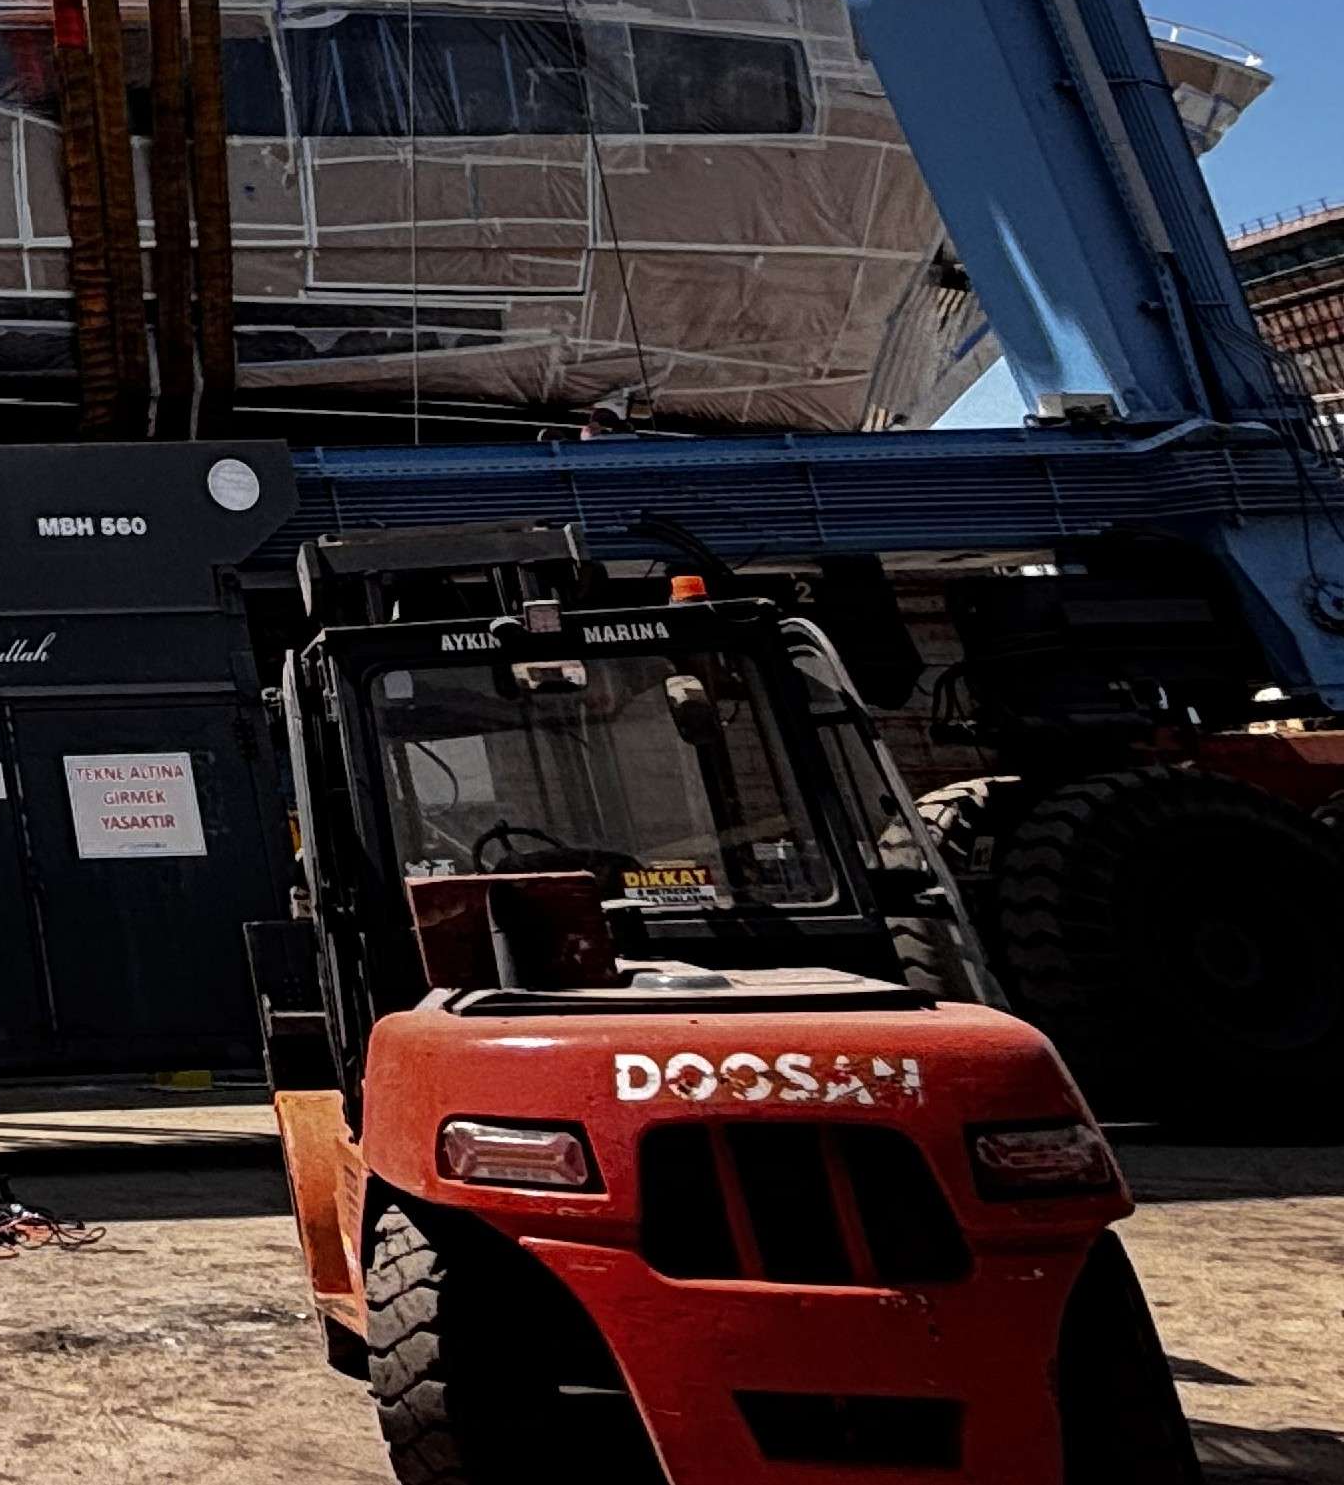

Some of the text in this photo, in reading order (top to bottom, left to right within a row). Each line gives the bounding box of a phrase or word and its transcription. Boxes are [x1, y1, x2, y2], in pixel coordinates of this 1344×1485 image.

[37, 517, 147, 536] MBH 560
[795, 581, 815, 603] 2
[583, 622, 670, 644] MARINA
[76, 764, 185, 781] TEKNE ALTINA
[100, 814, 176, 830] YASAKTIR
